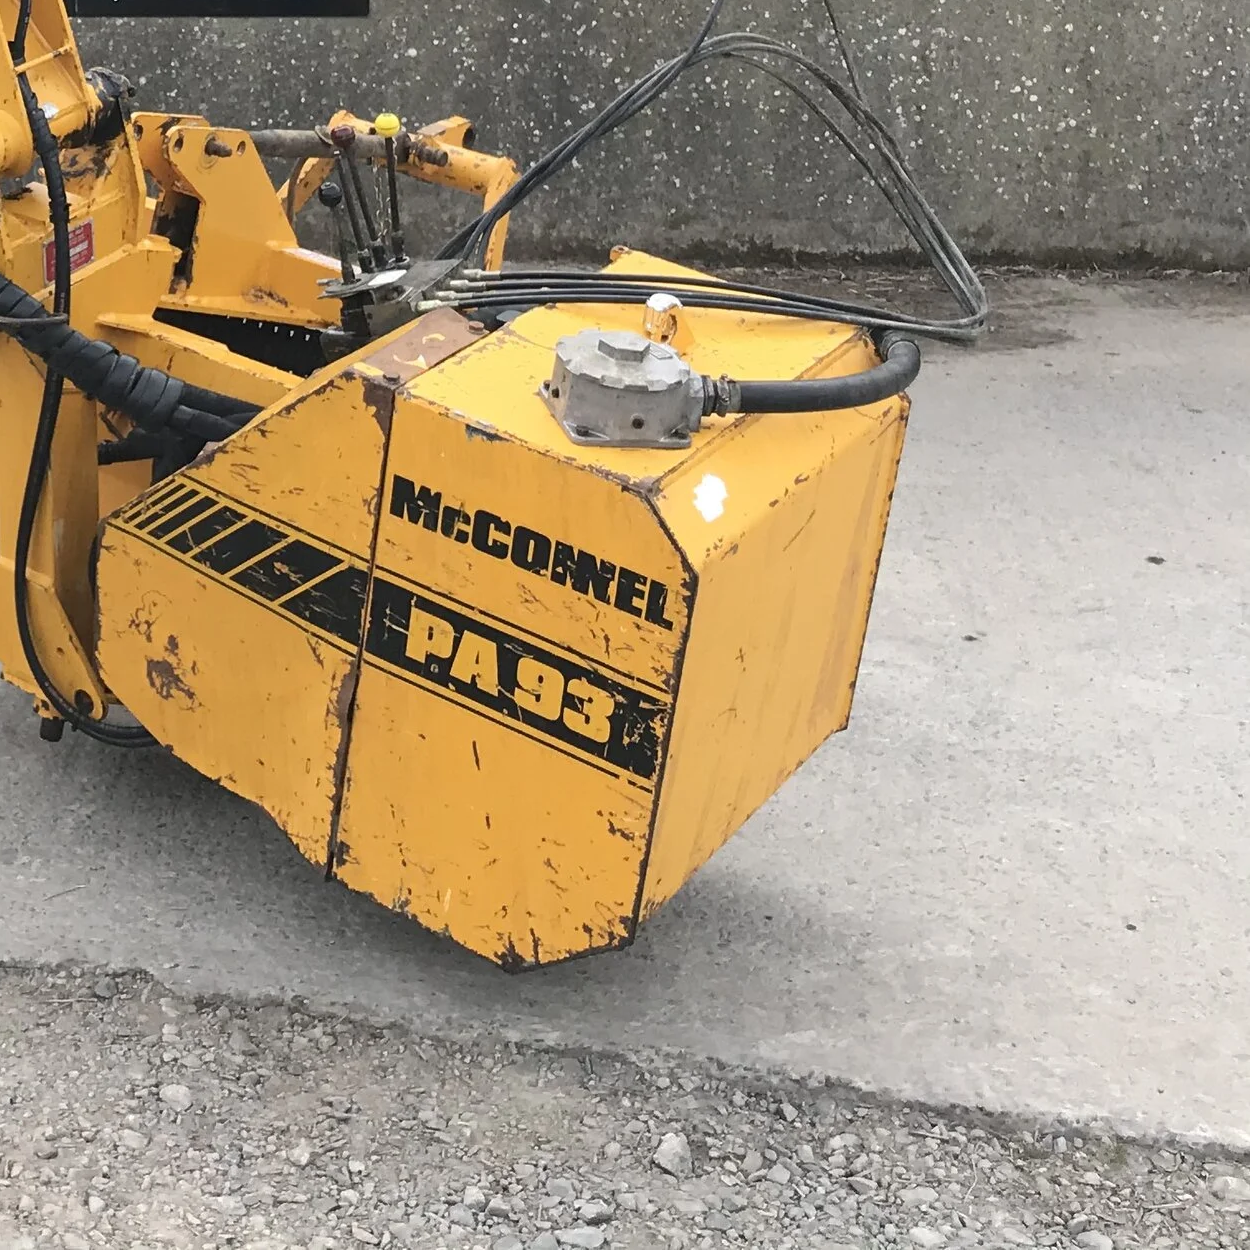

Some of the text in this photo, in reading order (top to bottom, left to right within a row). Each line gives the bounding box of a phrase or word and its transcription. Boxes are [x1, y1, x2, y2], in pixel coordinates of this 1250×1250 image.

[389, 473, 674, 629] McCONNEL
[404, 605, 616, 744] PA 93
